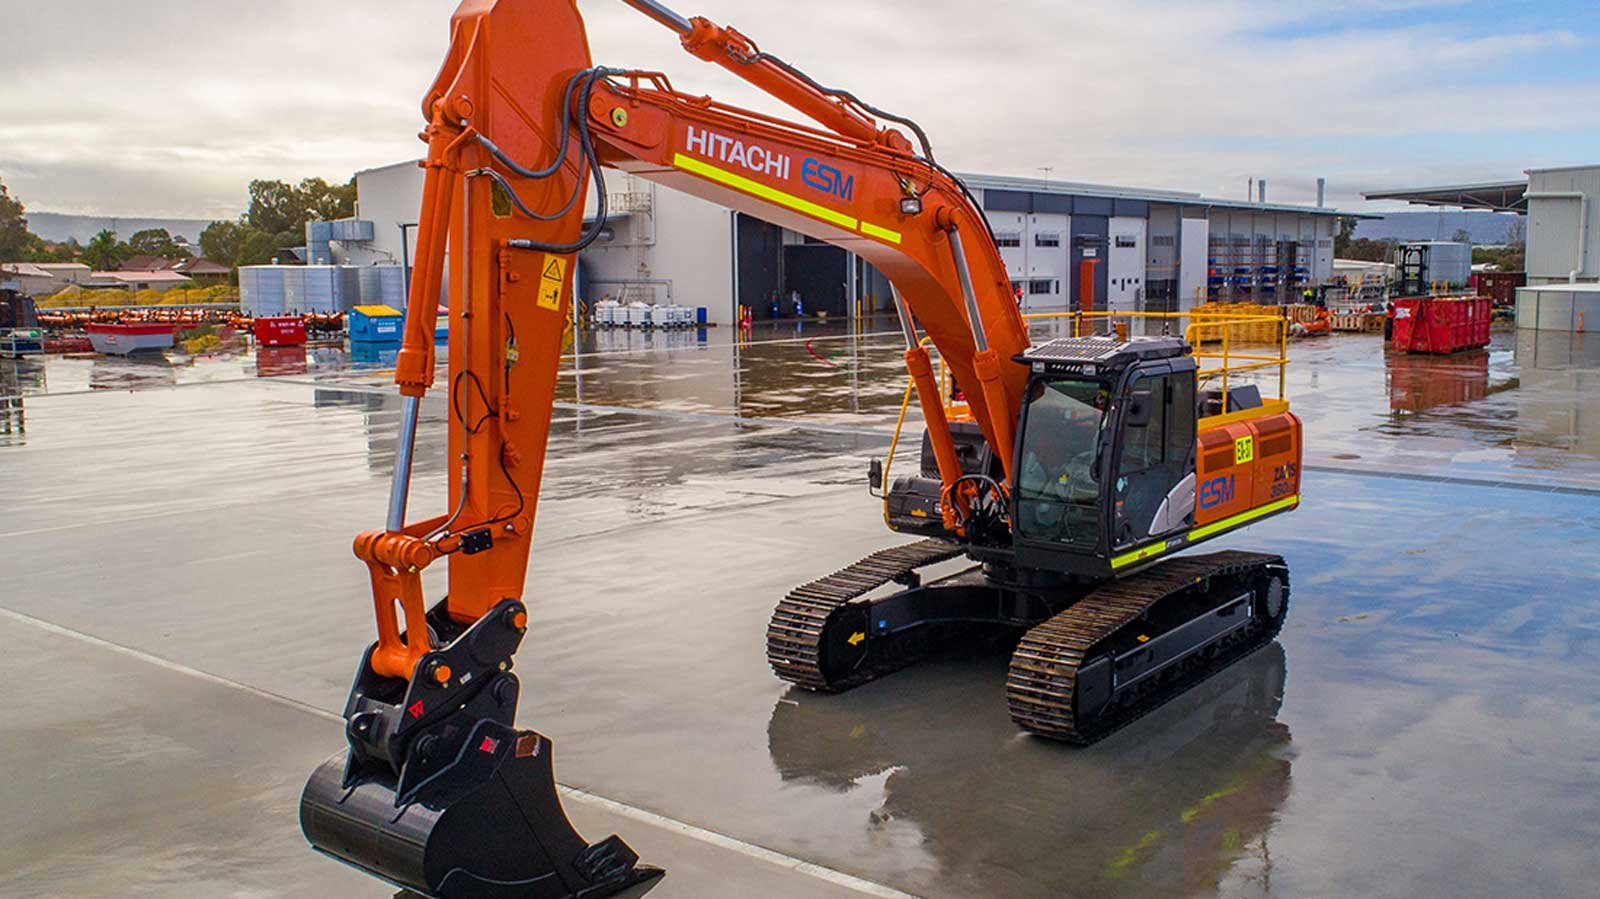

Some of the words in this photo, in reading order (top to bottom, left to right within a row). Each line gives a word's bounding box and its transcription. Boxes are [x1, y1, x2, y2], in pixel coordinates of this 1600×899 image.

[686, 125, 791, 180] HITACHI
[801, 157, 854, 201] ESM
[1200, 474, 1235, 509] ESM
